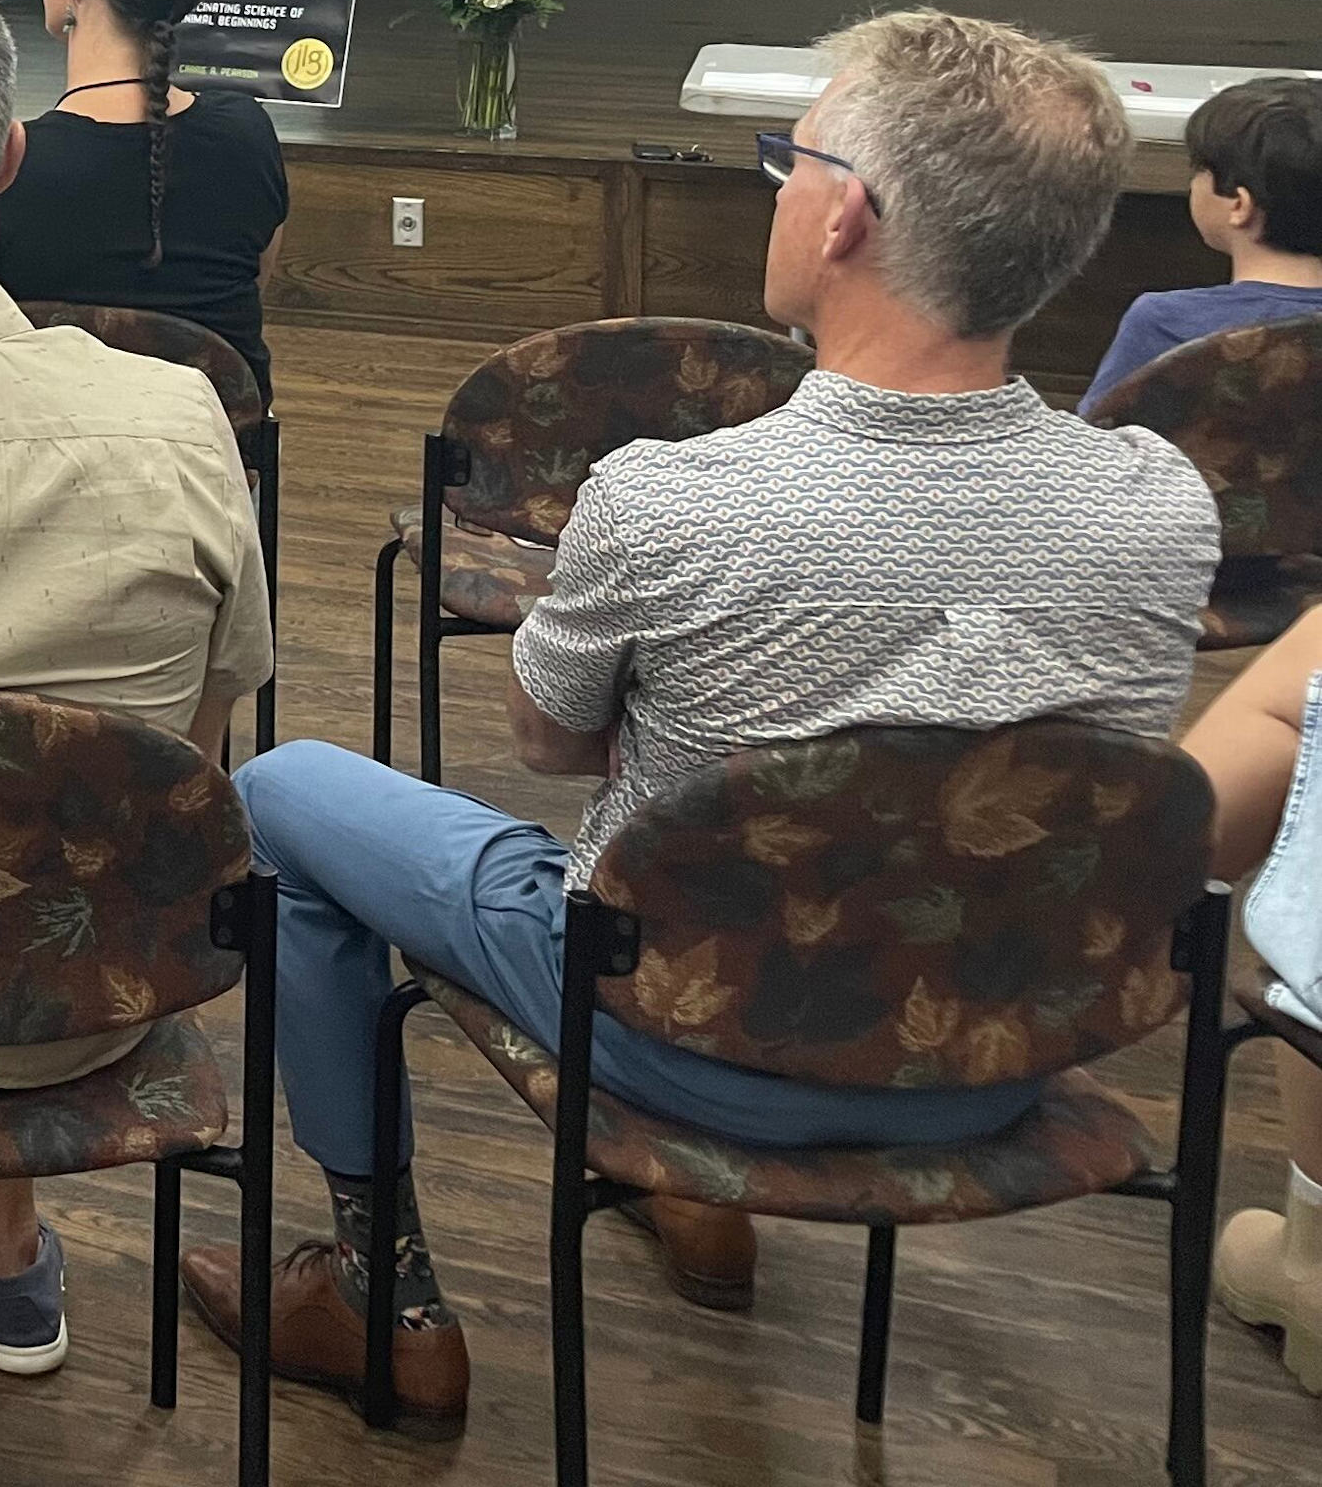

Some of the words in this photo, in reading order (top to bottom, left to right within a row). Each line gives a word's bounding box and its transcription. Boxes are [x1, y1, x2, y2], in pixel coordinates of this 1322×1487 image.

[192, 1, 241, 14] CINATING
[244, 4, 287, 18] SCIENCE
[289, 7, 305, 19] OF
[217, 15, 277, 30] BEGINNINGS
